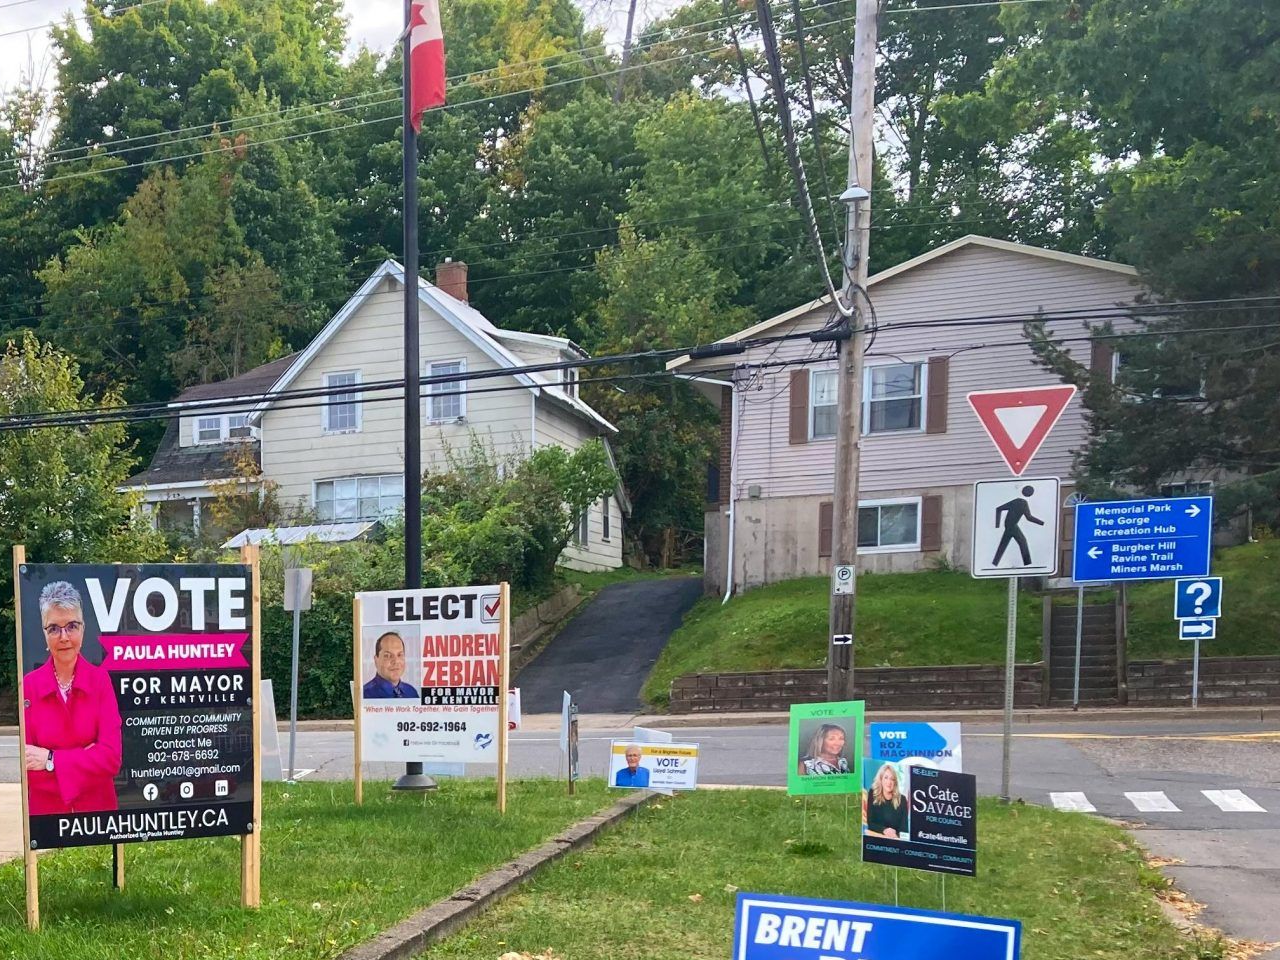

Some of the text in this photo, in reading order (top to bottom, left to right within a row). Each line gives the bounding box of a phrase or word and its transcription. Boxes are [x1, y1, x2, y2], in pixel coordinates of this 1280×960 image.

[1095, 504, 1171, 516] Memorial Park
[1094, 516, 1150, 526] The Gorge
[1094, 525, 1176, 537] Recreation Hub
[1112, 541, 1176, 553] Burgher Hill
[1111, 552, 1174, 563] Ravine Trail
[1111, 563, 1183, 574] Miners Marsh
[85, 577, 246, 632] VOTE
[387, 593, 477, 622] ELECT
[423, 633, 500, 657] ANDREW
[113, 643, 235, 661] PAULA HUNTLEY
[423, 660, 500, 687] ZEBIAN
[120, 674, 243, 695] FOR MAYOR
[430, 687, 494, 697] FOR MAYOR
[133, 693, 235, 705] OF KENTVILLE
[424, 696, 499, 704] OF KENTVILLE
[125, 713, 241, 727] COMMITTED TO COMMUNITY
[141, 724, 228, 736] DRIVEN BY PROGRESS
[397, 721, 467, 732] 902-692-1964
[879, 731, 907, 740] VOTE
[154, 738, 212, 749] Contact Me
[880, 741, 903, 749] ROZ
[147, 749, 219, 762] 902-678-6692
[880, 749, 953, 758] MACKINNON
[657, 758, 679, 768] VOTE
[912, 767, 939, 778] RE-ELECT
[928, 784, 959, 803] Cate
[912, 789, 972, 819] SAVAGE
[58, 808, 229, 837] PAULAHUNTLEY.CA
[926, 815, 938, 824] FOR
[754, 912, 873, 954] BRENT
